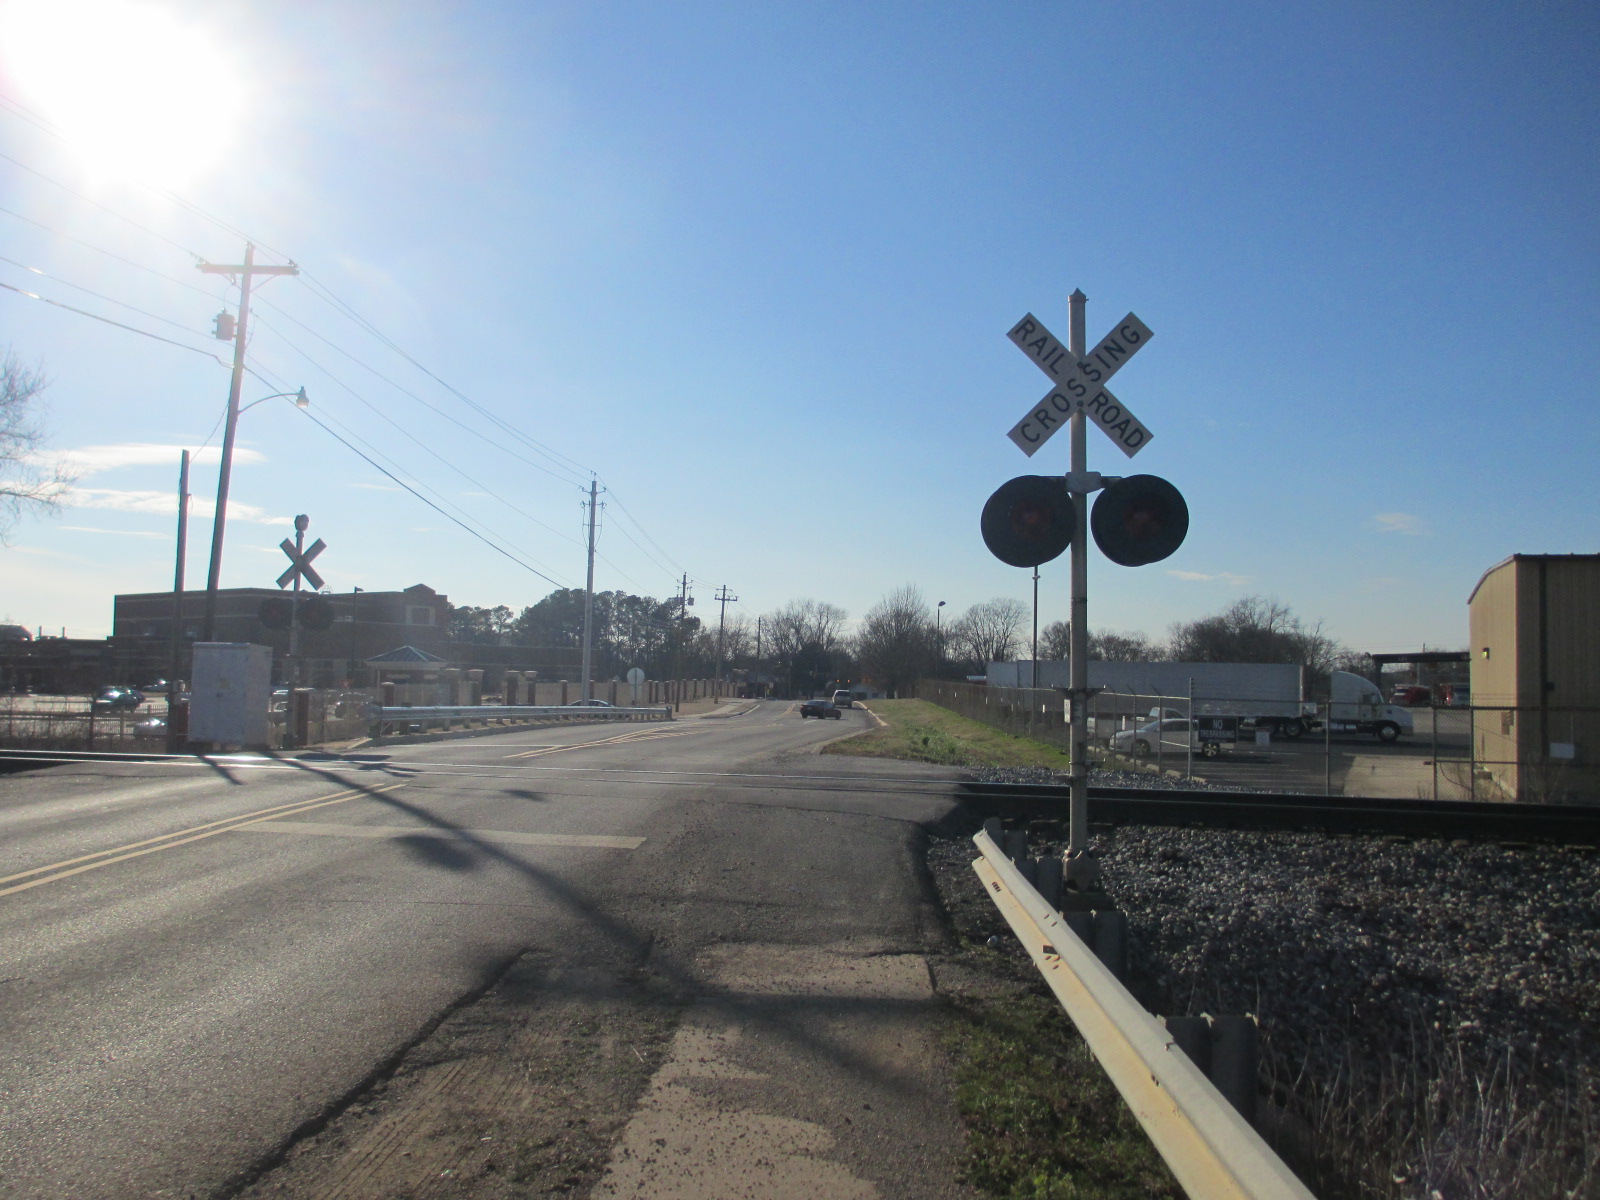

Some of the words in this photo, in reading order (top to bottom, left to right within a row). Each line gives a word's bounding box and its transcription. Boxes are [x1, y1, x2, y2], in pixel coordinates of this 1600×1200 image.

[1014, 319, 1065, 375] RAIL
[1087, 392, 1144, 448] ROAD
[1020, 325, 1141, 443] CROSSING
[1200, 729, 1235, 739] TRESPASSING
[1212, 719, 1223, 730] NO
